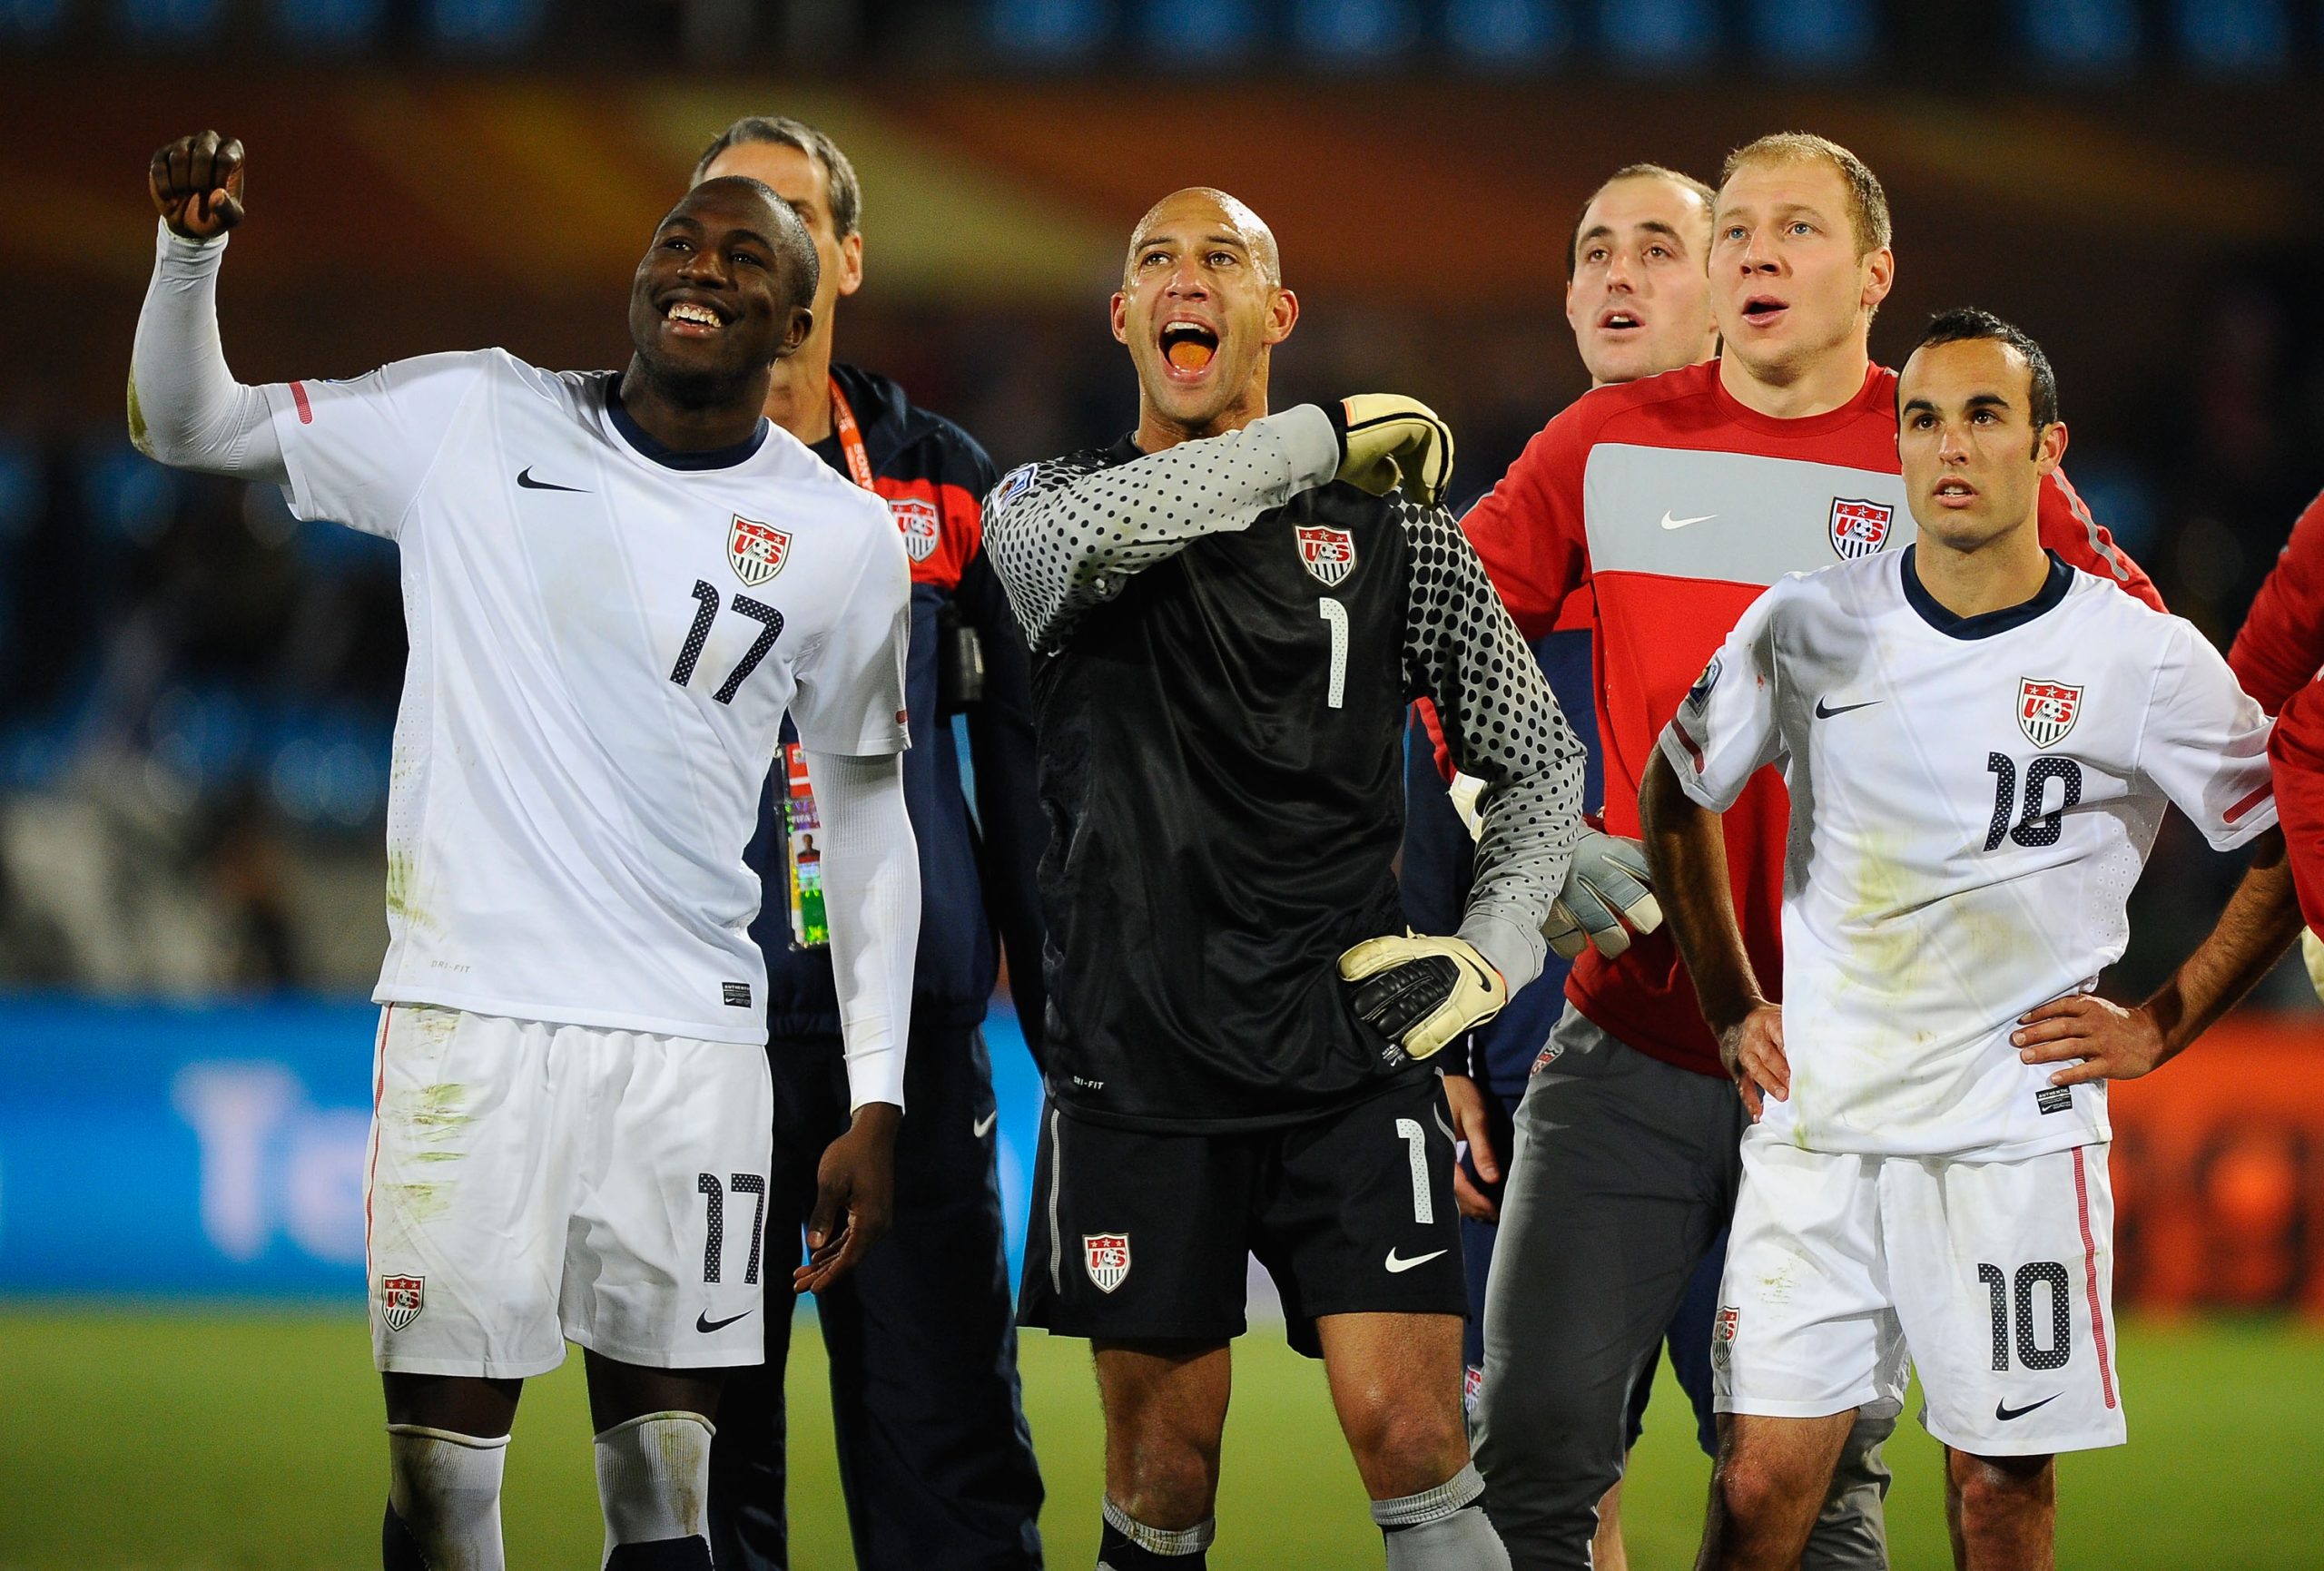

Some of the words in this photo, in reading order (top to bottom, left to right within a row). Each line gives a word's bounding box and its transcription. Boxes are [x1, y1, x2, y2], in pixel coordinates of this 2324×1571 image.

[853, 443, 875, 491] SONY
[1836, 516, 1885, 543] US
[734, 534, 782, 565] US
[1305, 542, 1351, 563] US
[669, 578, 785, 706] 17
[1319, 596, 1349, 709] 1
[2023, 697, 2073, 723] US
[1983, 751, 2083, 852] 10
[430, 959, 471, 973] DRI-FIT
[1395, 1118, 1434, 1224] 1
[697, 1172, 766, 1285] 17
[1091, 1249, 1126, 1269] US
[387, 1291, 419, 1310] US
[1977, 1261, 2072, 1372] 10
